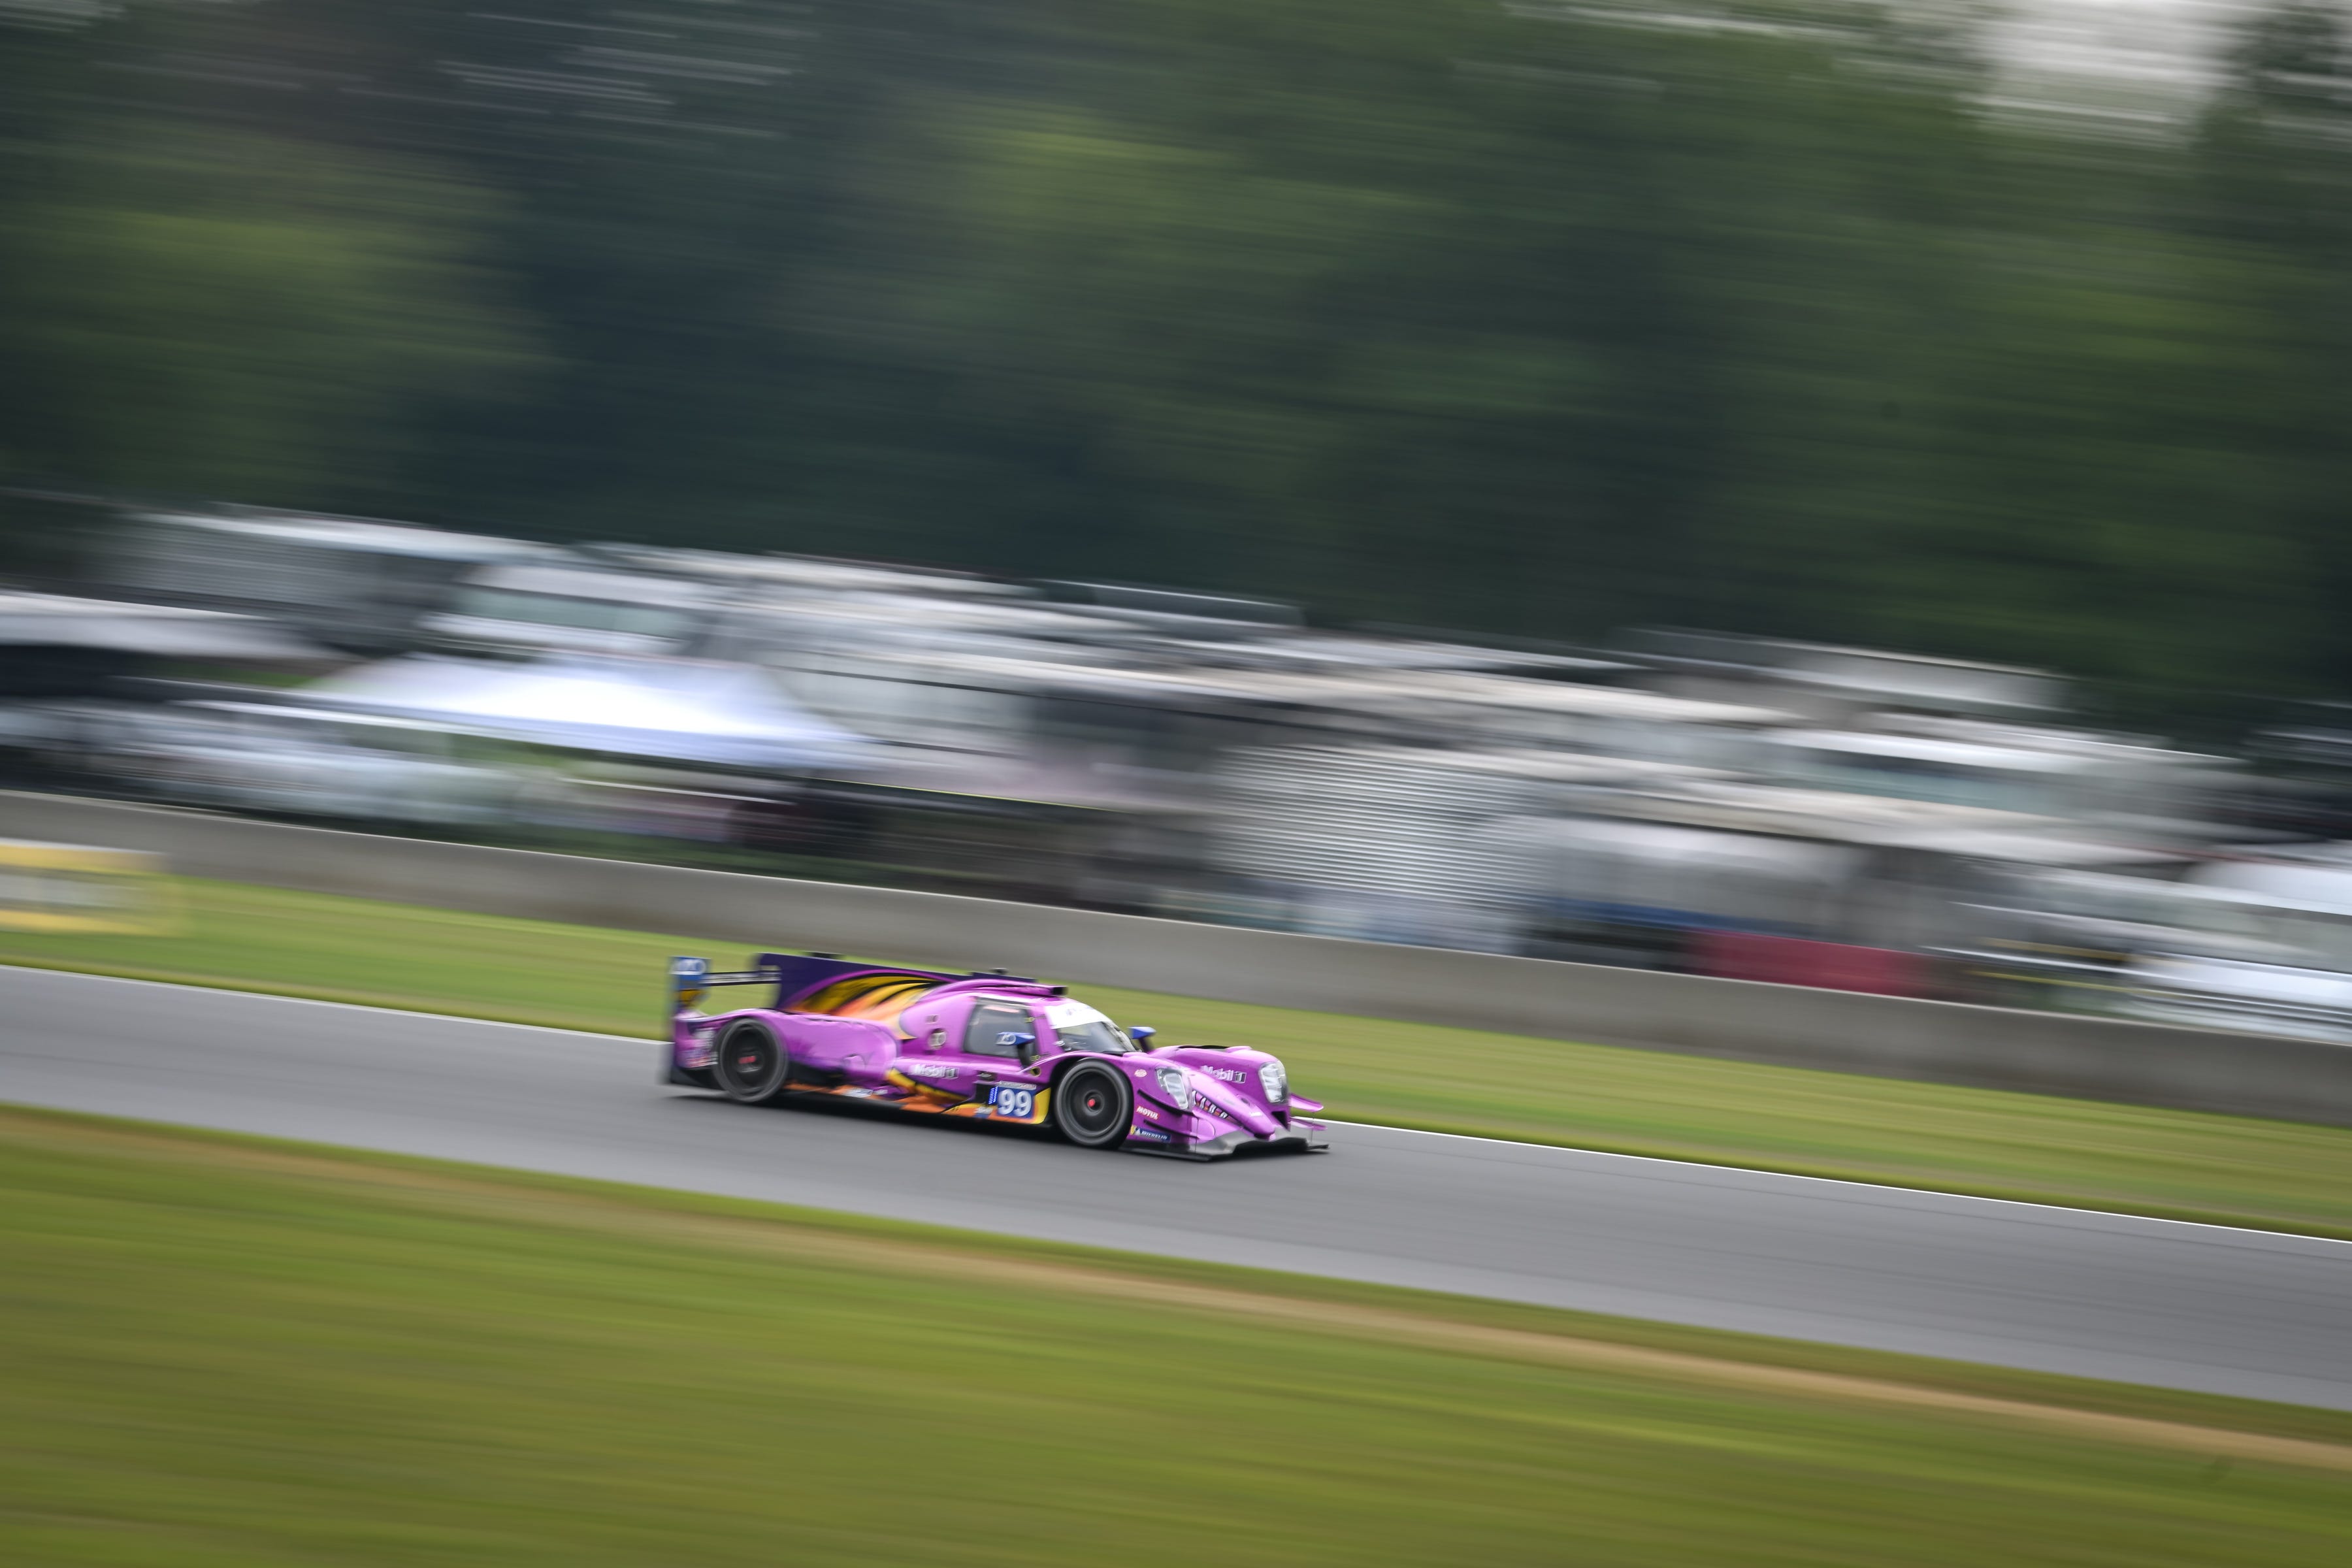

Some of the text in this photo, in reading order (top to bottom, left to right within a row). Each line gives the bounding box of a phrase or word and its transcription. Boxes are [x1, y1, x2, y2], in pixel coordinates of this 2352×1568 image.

[1200, 1065, 1234, 1081] Mobil
[998, 1089, 1032, 1117] 99
[1137, 1105, 1158, 1120] MOTUL
